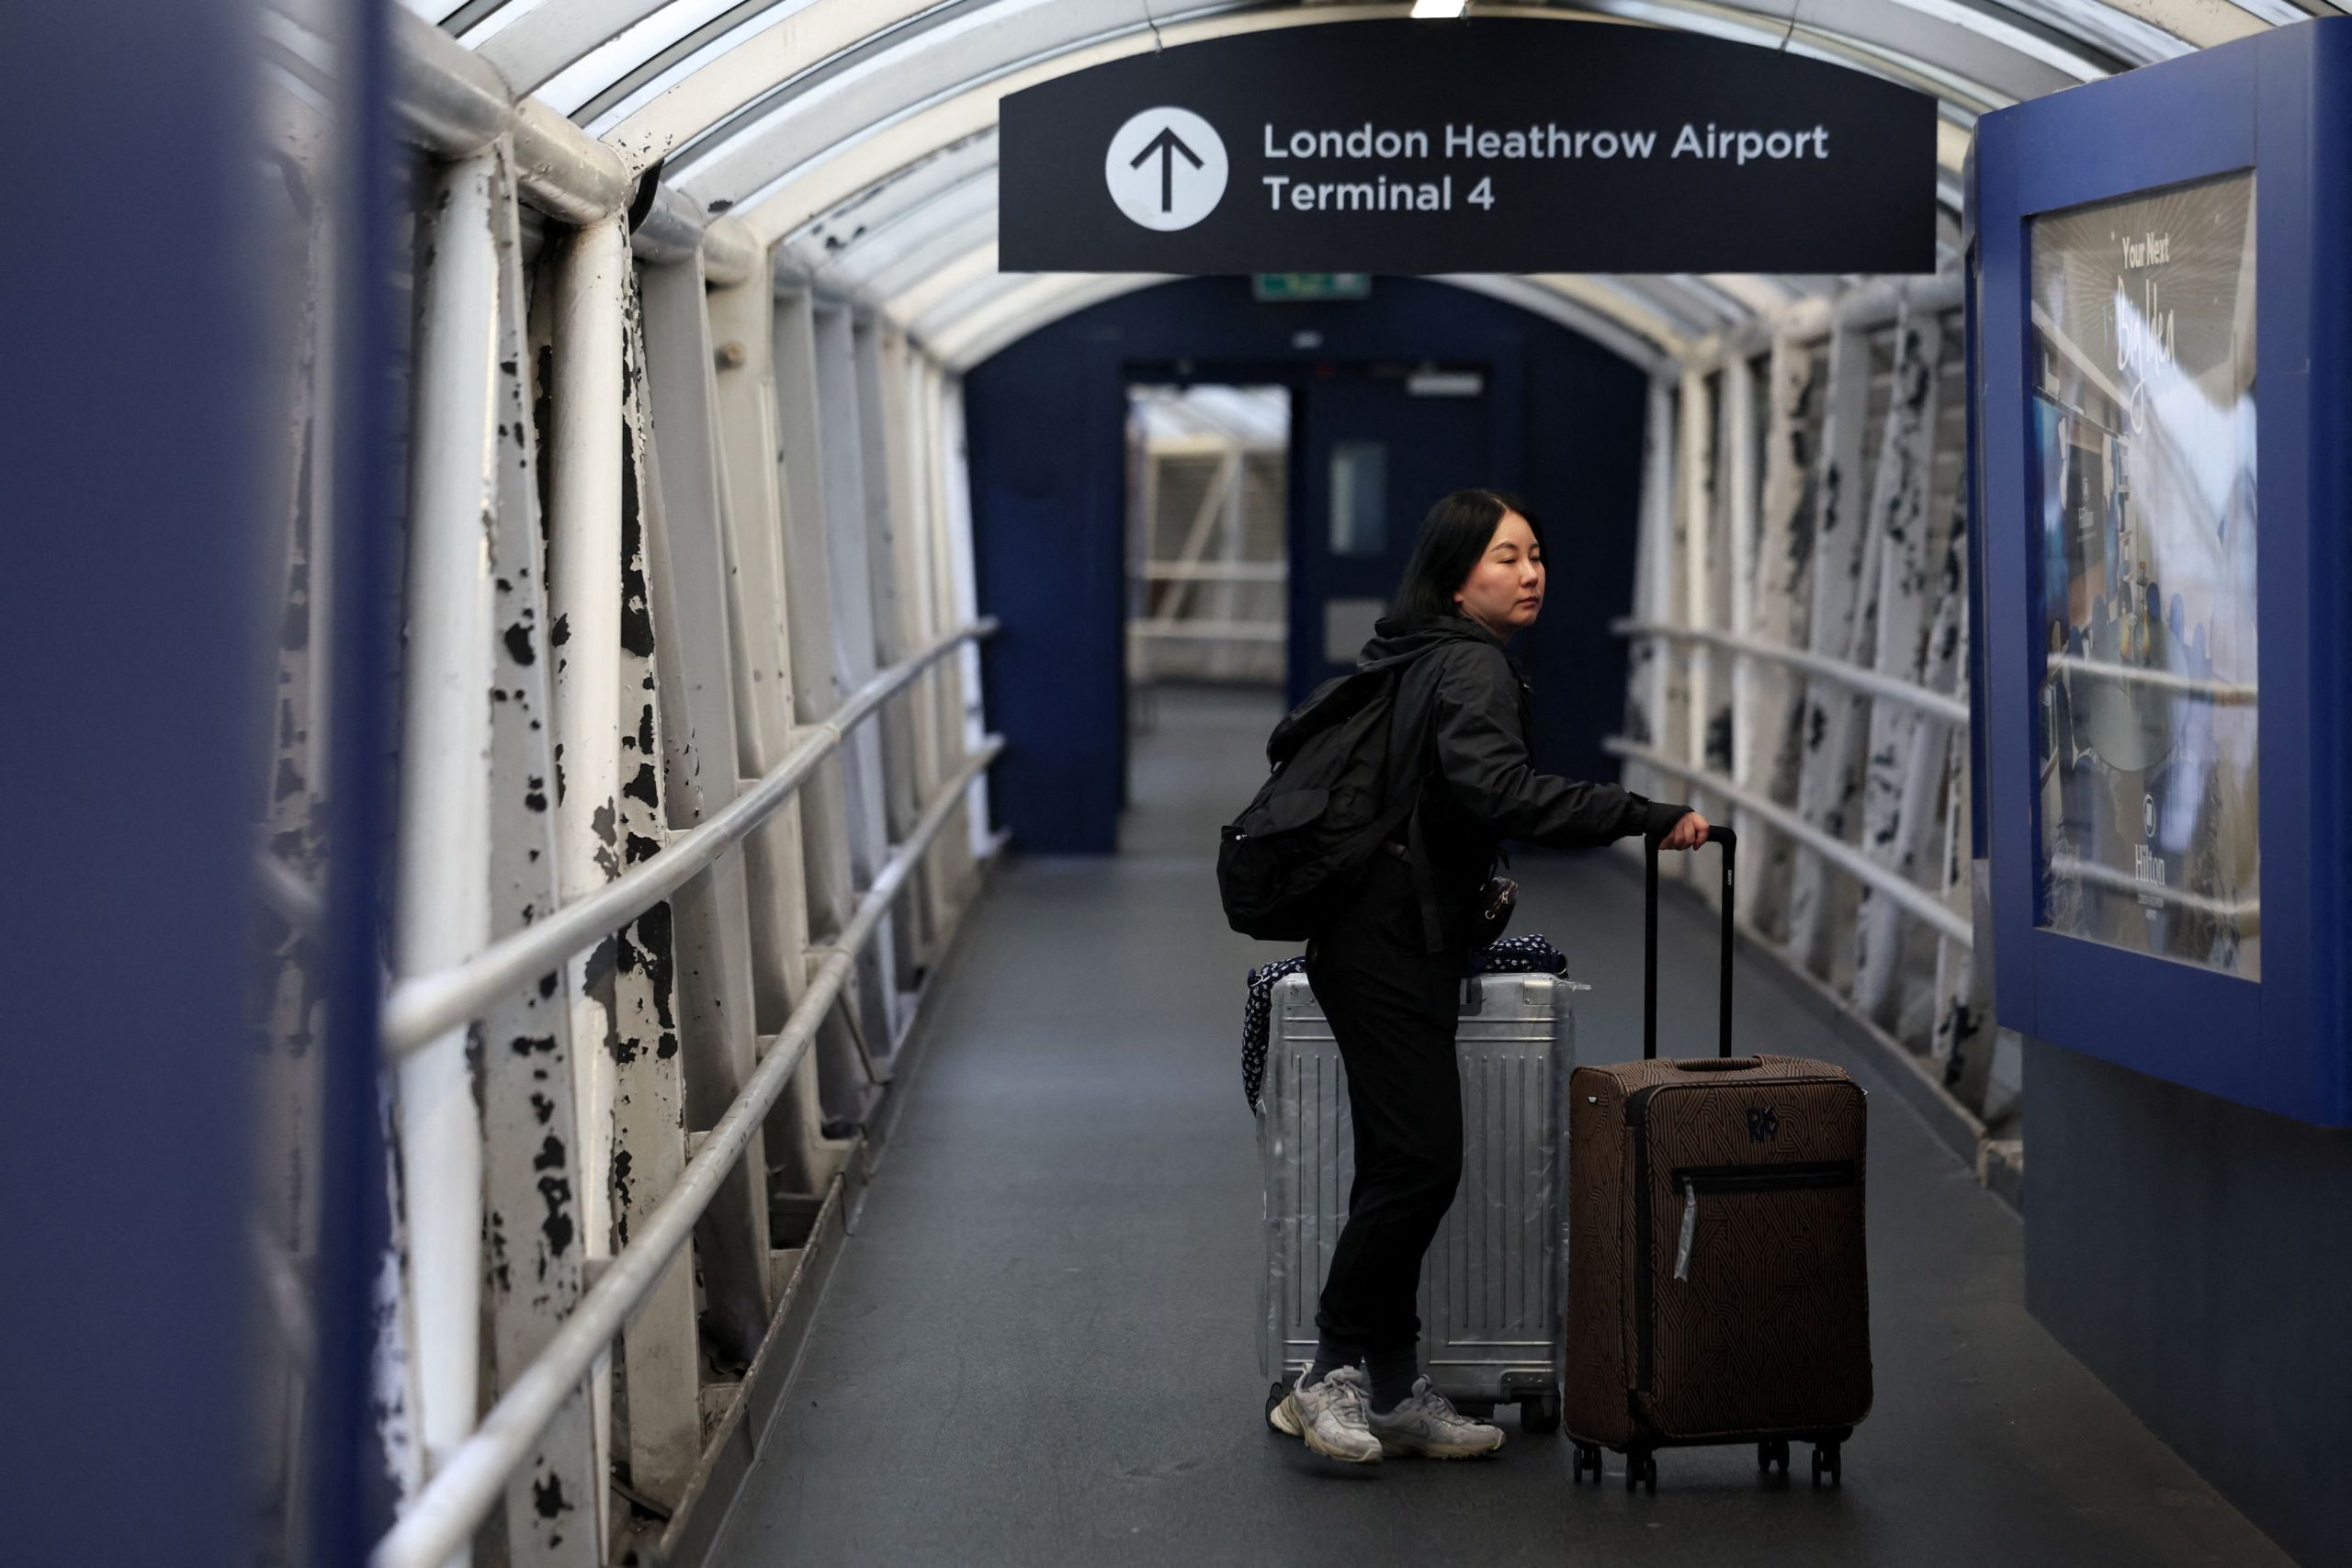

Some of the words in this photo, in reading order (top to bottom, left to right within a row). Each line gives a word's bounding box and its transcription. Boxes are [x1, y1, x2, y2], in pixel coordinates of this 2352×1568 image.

[1263, 122, 1429, 160] London
[1445, 123, 1657, 160] Heathrow
[1671, 123, 1830, 165] Airport
[1262, 175, 1453, 212] Terminal
[1467, 176, 1496, 211] 4
[2121, 236, 2145, 270] Your
[2146, 231, 2170, 265] Next
[2117, 275, 2146, 434] Big
[2135, 844, 2165, 886] Hilton
